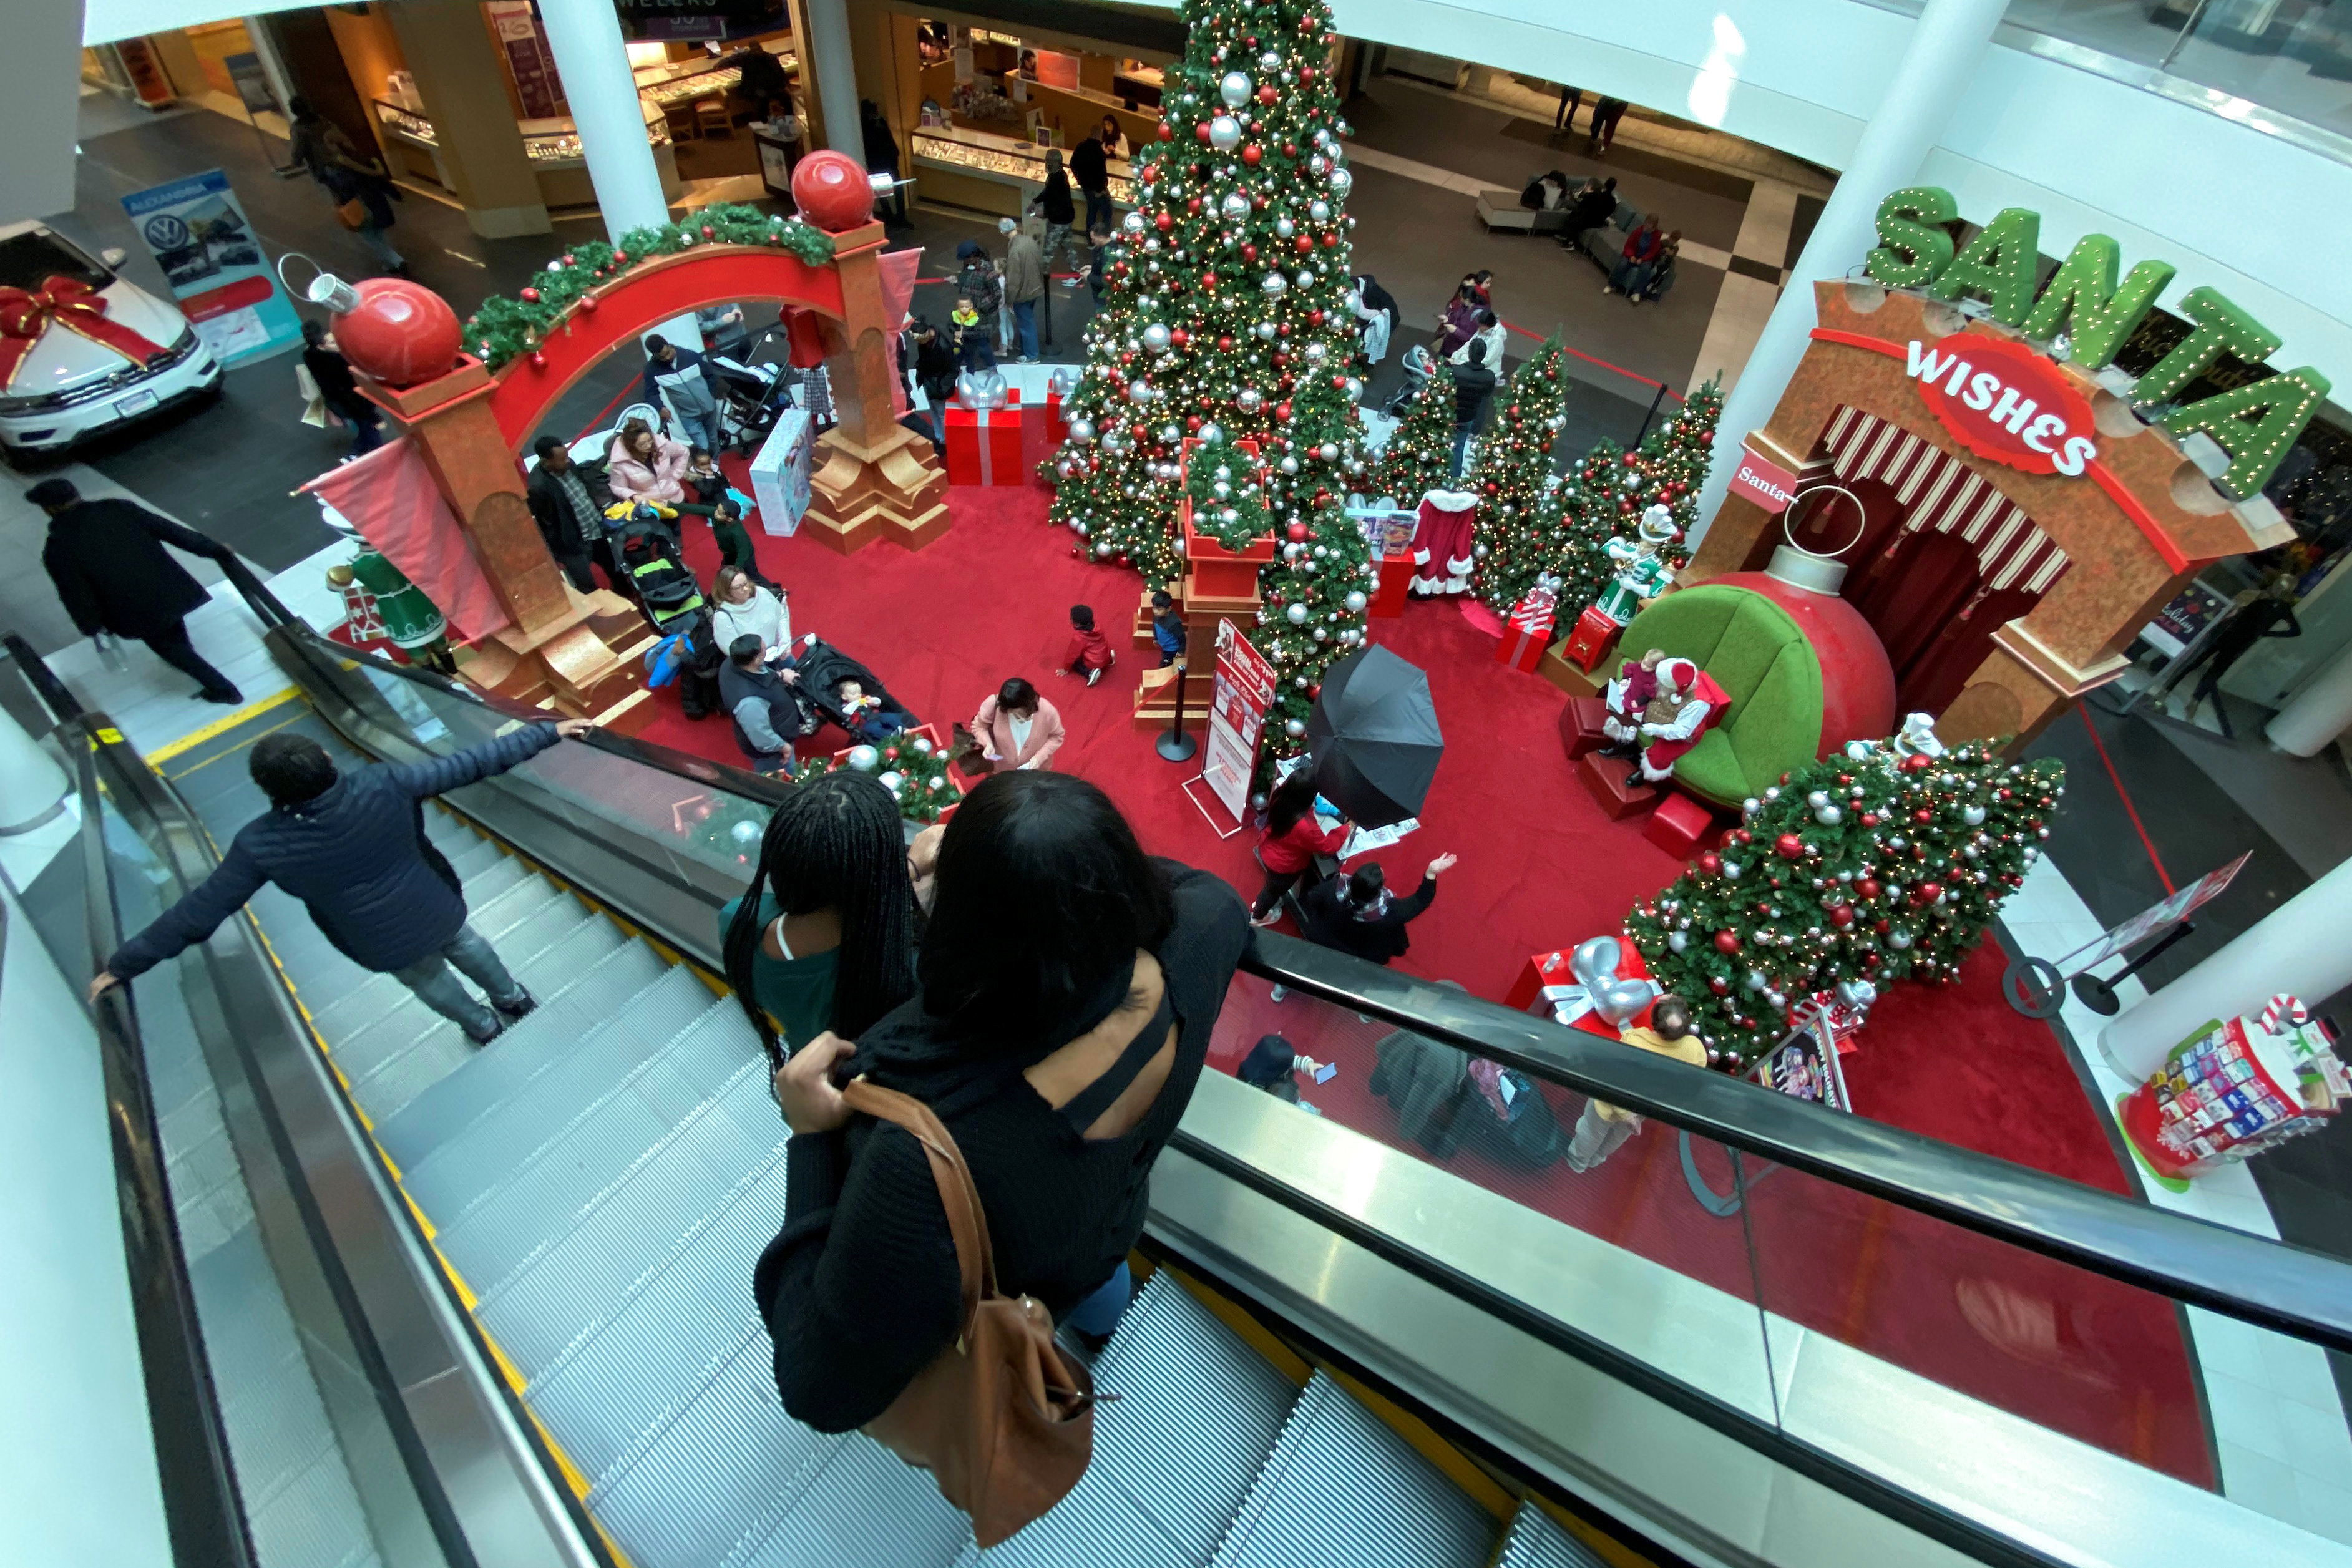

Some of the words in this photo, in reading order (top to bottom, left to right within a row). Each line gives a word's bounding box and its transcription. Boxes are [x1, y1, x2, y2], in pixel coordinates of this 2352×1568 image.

[1866, 186, 2332, 499] SANTA
[1907, 340, 2096, 476] WISHES
[1737, 466, 1787, 502] Santa
[1815, 1032, 1826, 1062] HAPPY
